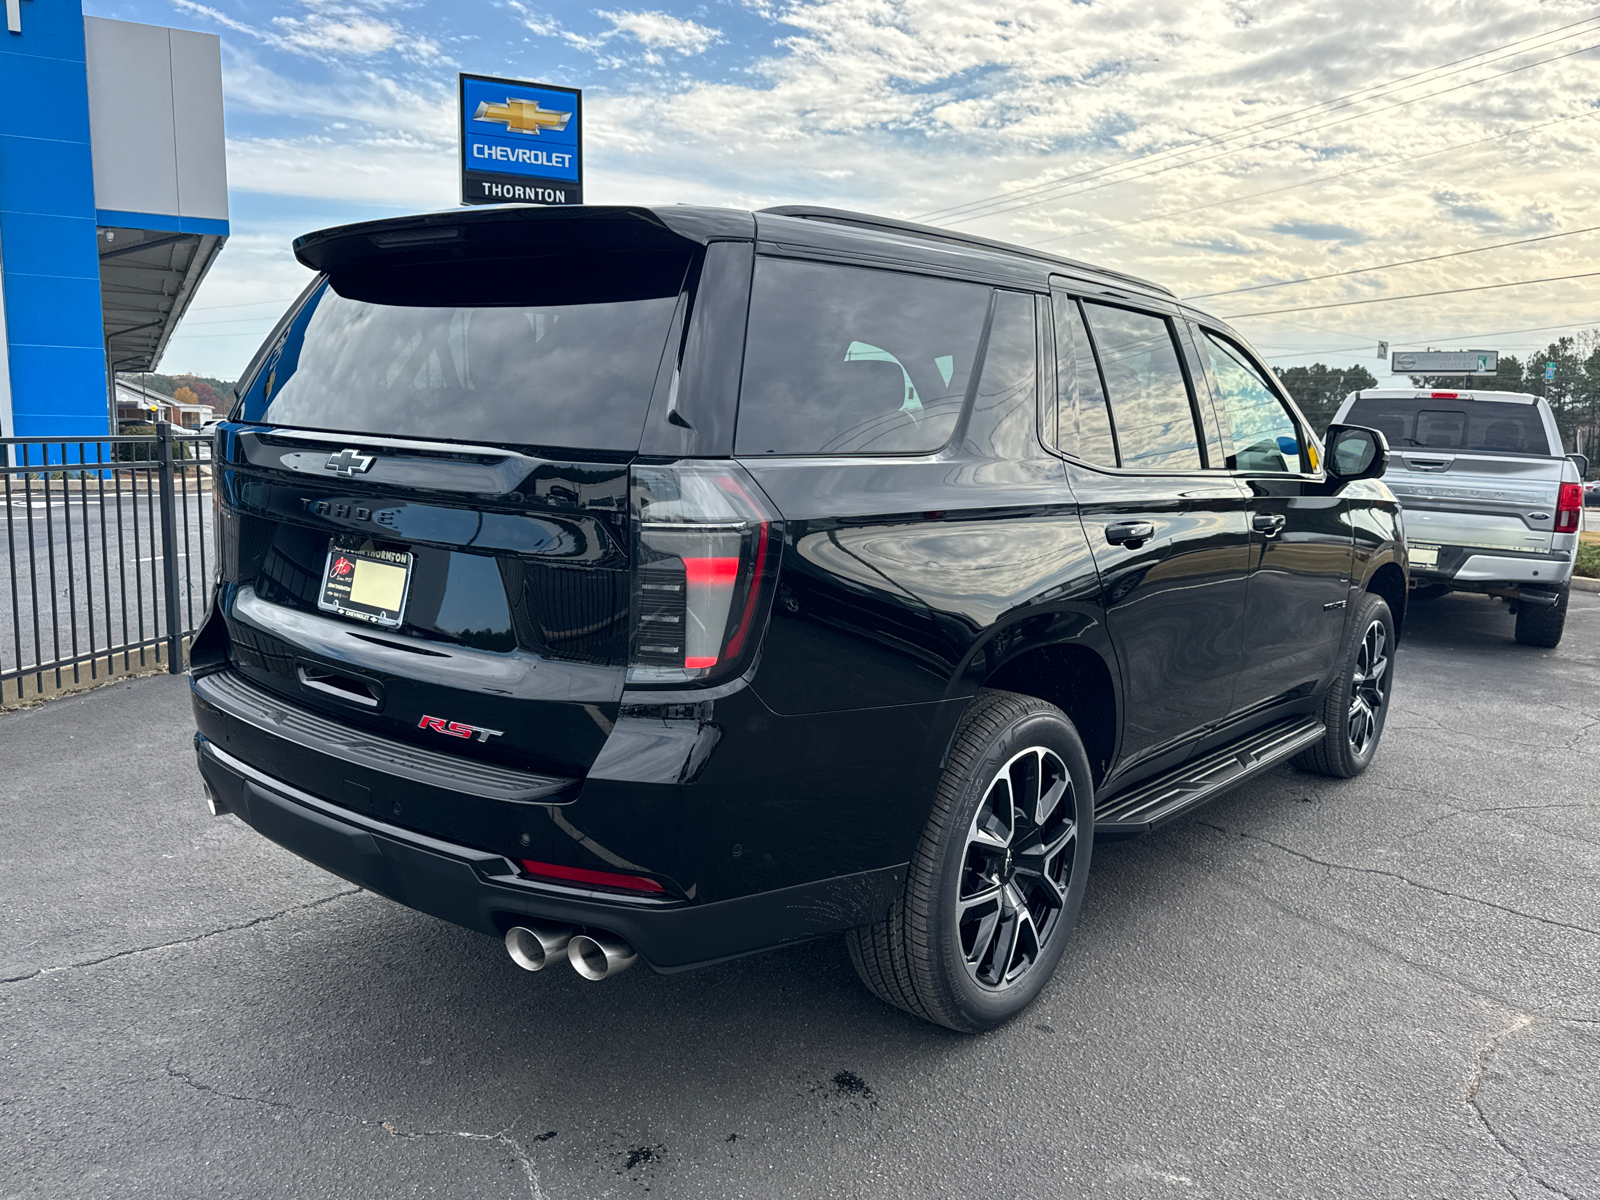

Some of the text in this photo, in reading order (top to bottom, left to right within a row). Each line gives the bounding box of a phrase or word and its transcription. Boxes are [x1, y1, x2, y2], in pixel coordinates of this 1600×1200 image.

[473, 143, 572, 168] CHEVROLET
[482, 182, 565, 203] THORNTON
[300, 497, 394, 526] TAHOE
[345, 610, 370, 621] CHEVROLET
[417, 714, 505, 743] RST
